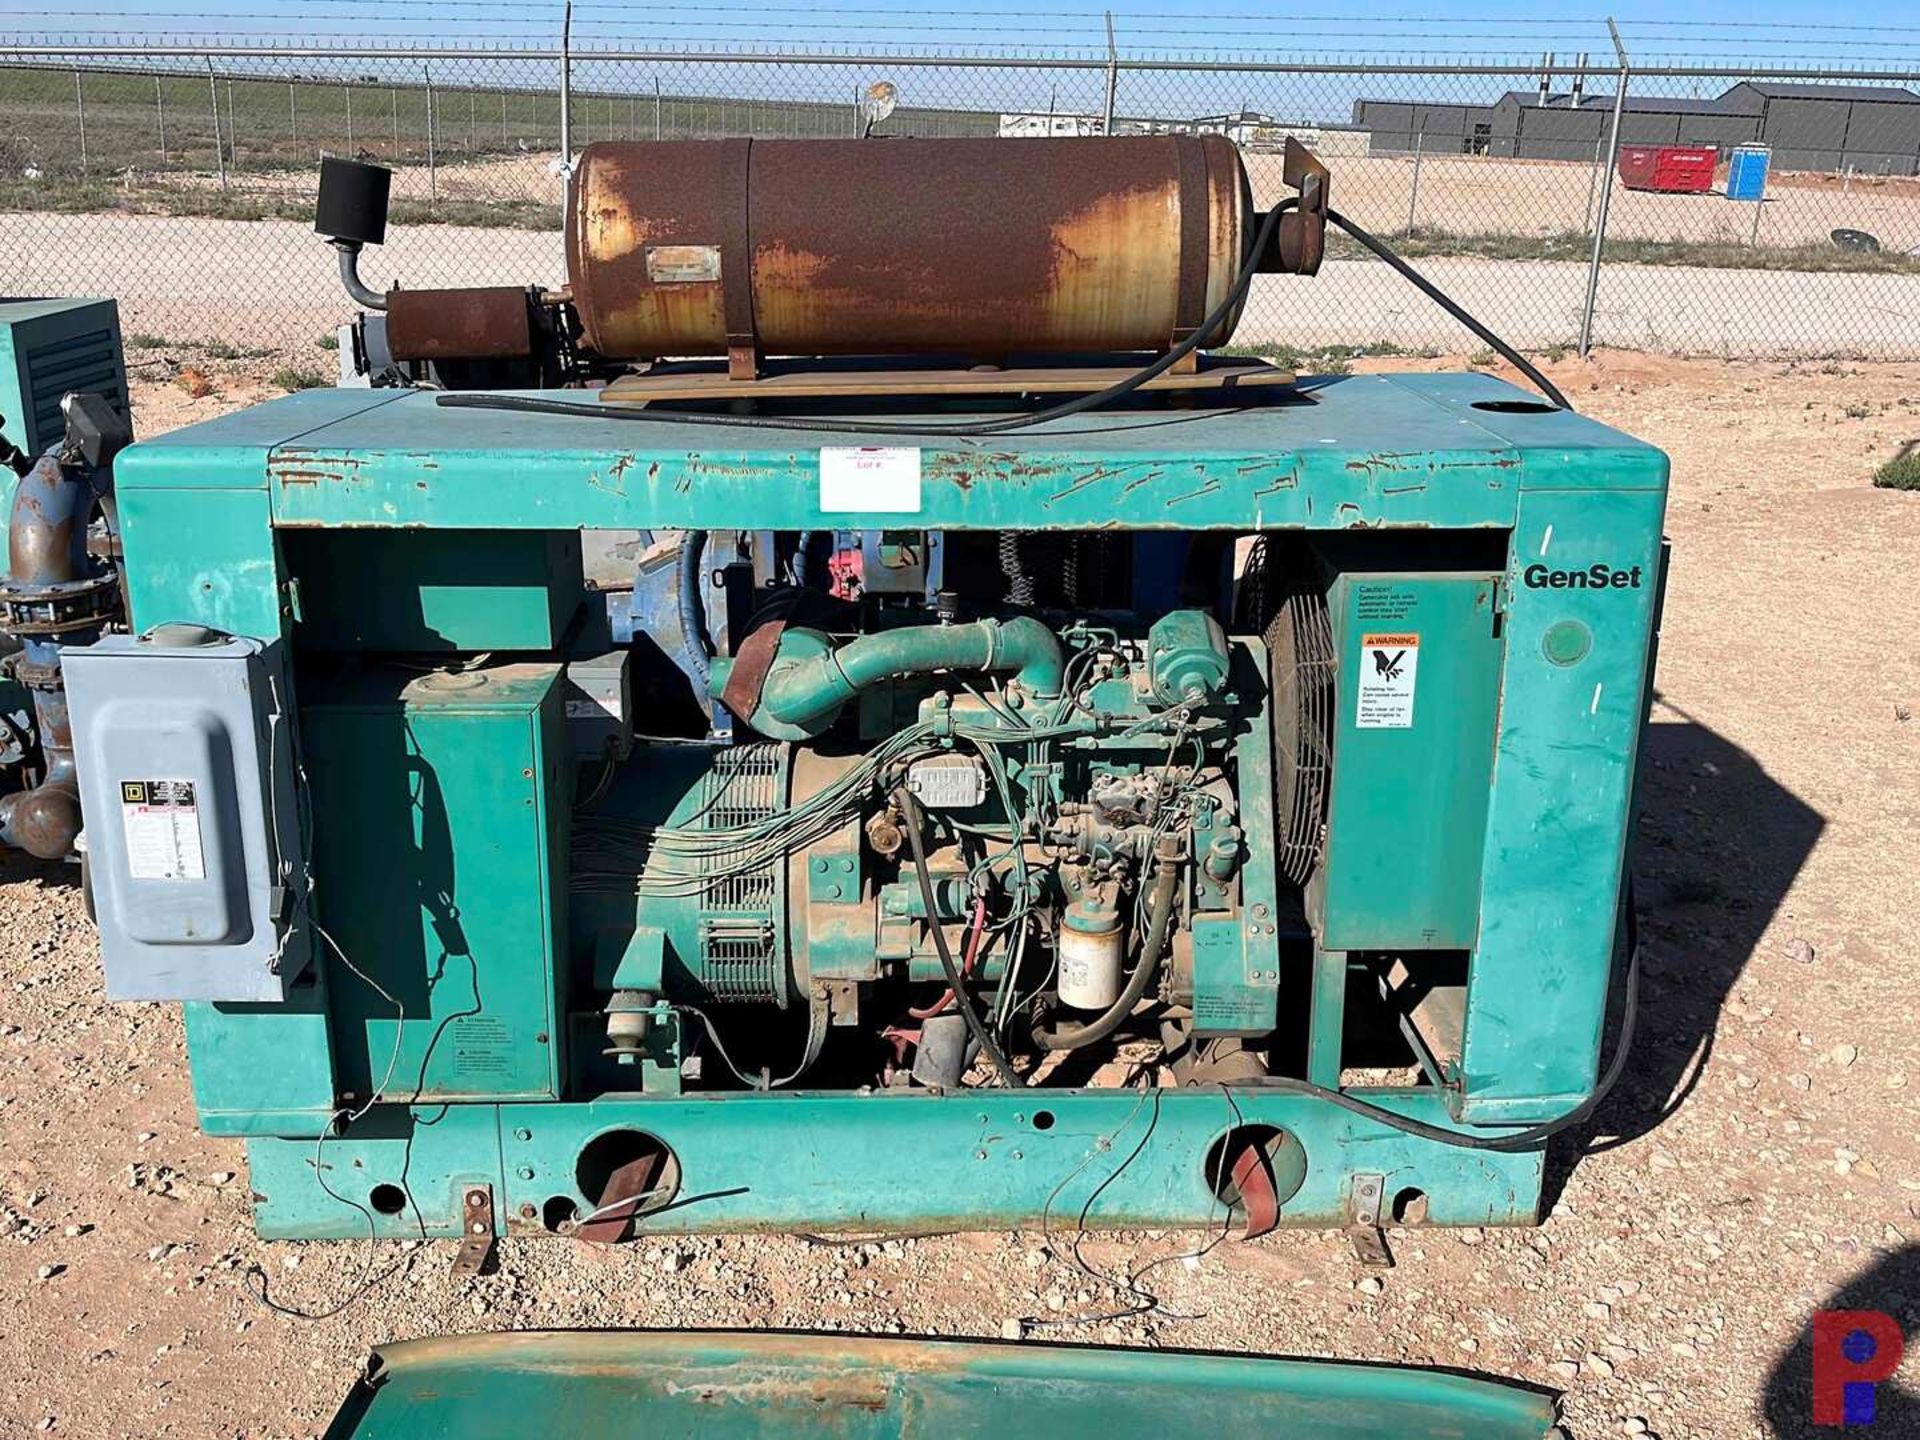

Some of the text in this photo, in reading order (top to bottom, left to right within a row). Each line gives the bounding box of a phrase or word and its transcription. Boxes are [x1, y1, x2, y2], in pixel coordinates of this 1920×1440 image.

[1524, 564, 1642, 589] GenSet
[1359, 585, 1393, 593] Caution!
[1375, 636, 1416, 645] WARNING
